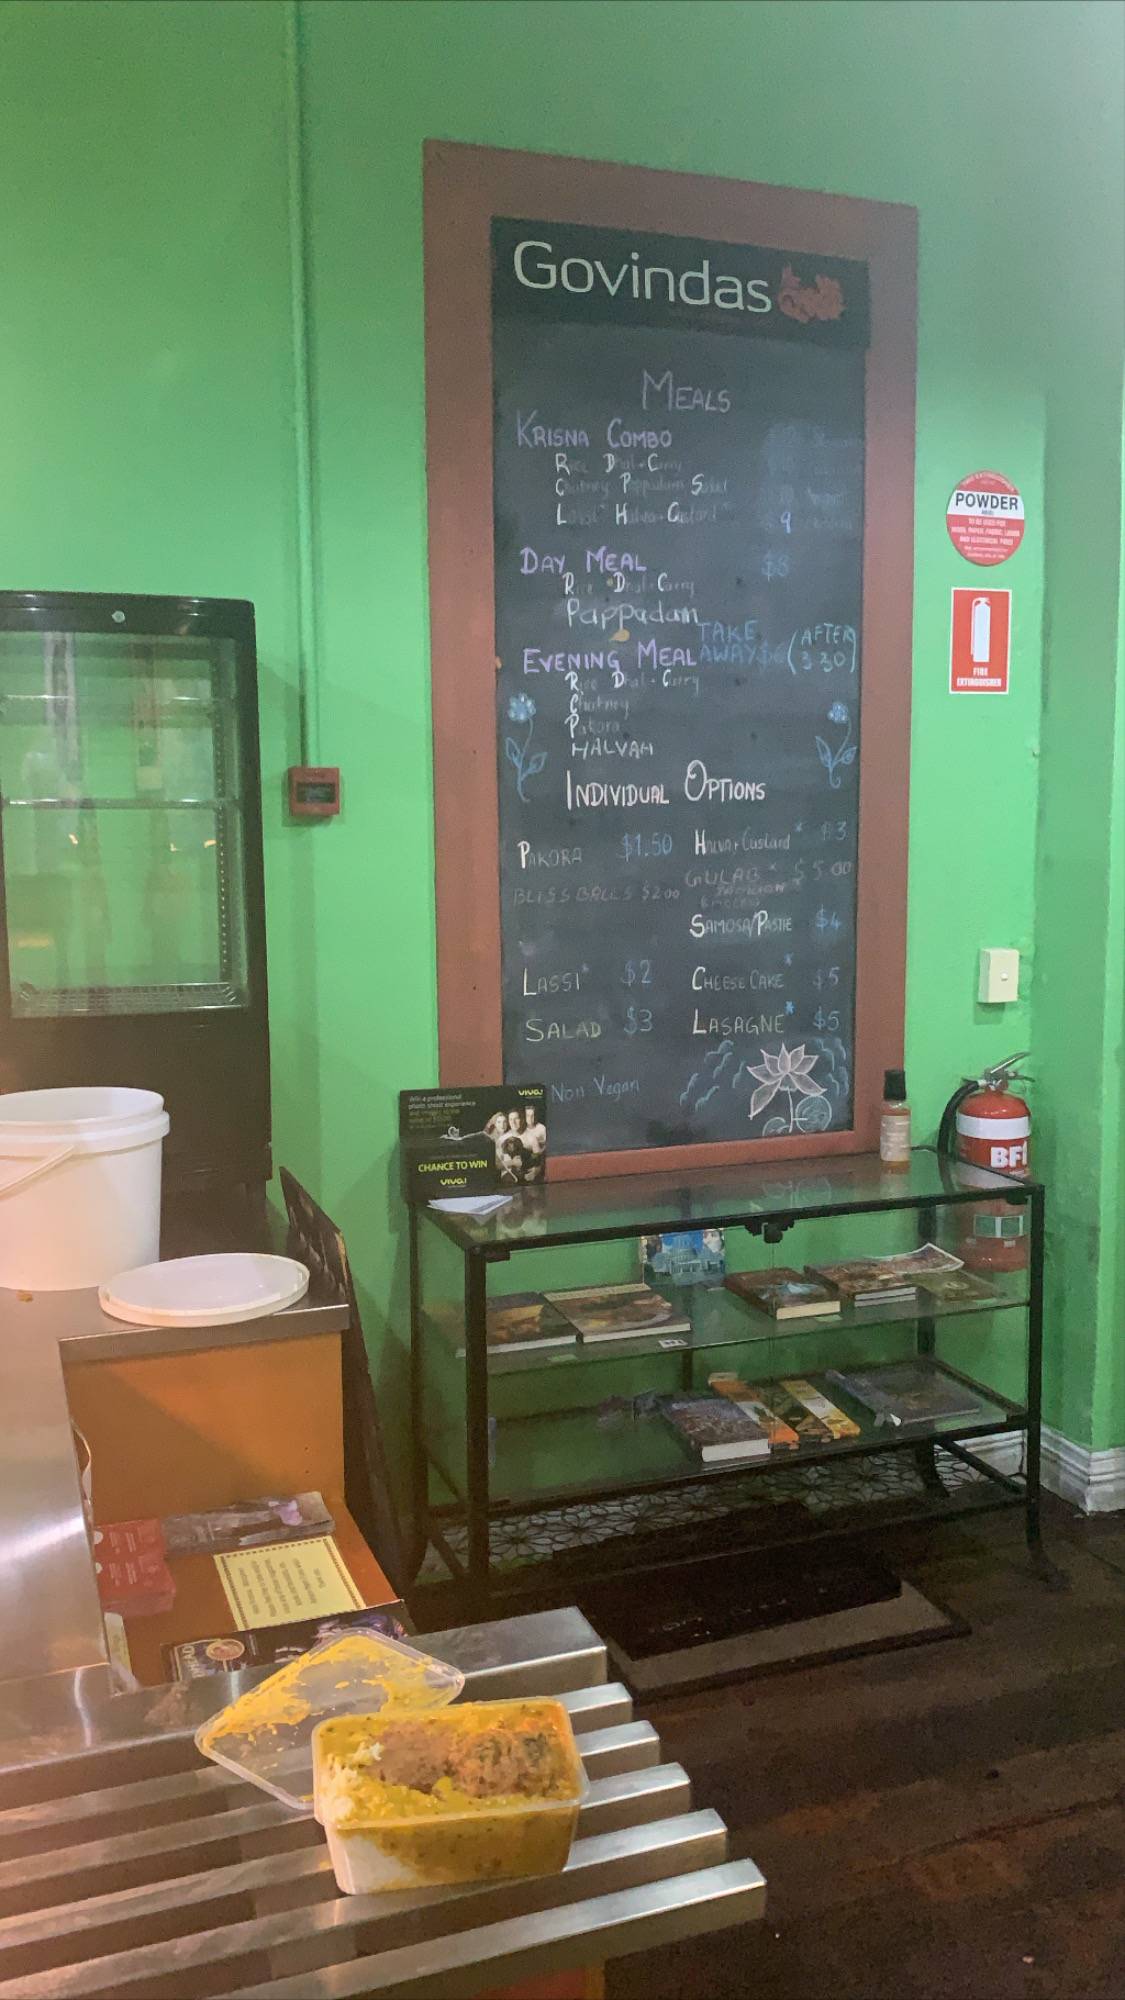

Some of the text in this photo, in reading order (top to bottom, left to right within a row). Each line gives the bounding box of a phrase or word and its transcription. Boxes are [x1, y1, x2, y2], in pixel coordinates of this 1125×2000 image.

[513, 240, 773, 313] Govindas
[643, 370, 731, 413] MEALS
[516, 408, 672, 448] KRISNA COMBO
[955, 492, 1018, 511] POWDER
[520, 545, 647, 575] DAY MEAL
[698, 620, 758, 643] TAKE
[523, 638, 697, 674] EVENING MEAL
[566, 759, 766, 810] INDIVIDUAL OPTIONS
[617, 832, 673, 862] $1.50
[523, 960, 652, 997] LASSI $2
[526, 1006, 653, 1042] SALAD $3
[693, 1006, 840, 1035] LASAGNE $5
[418, 1159, 488, 1173] CHANCE TO WIN
